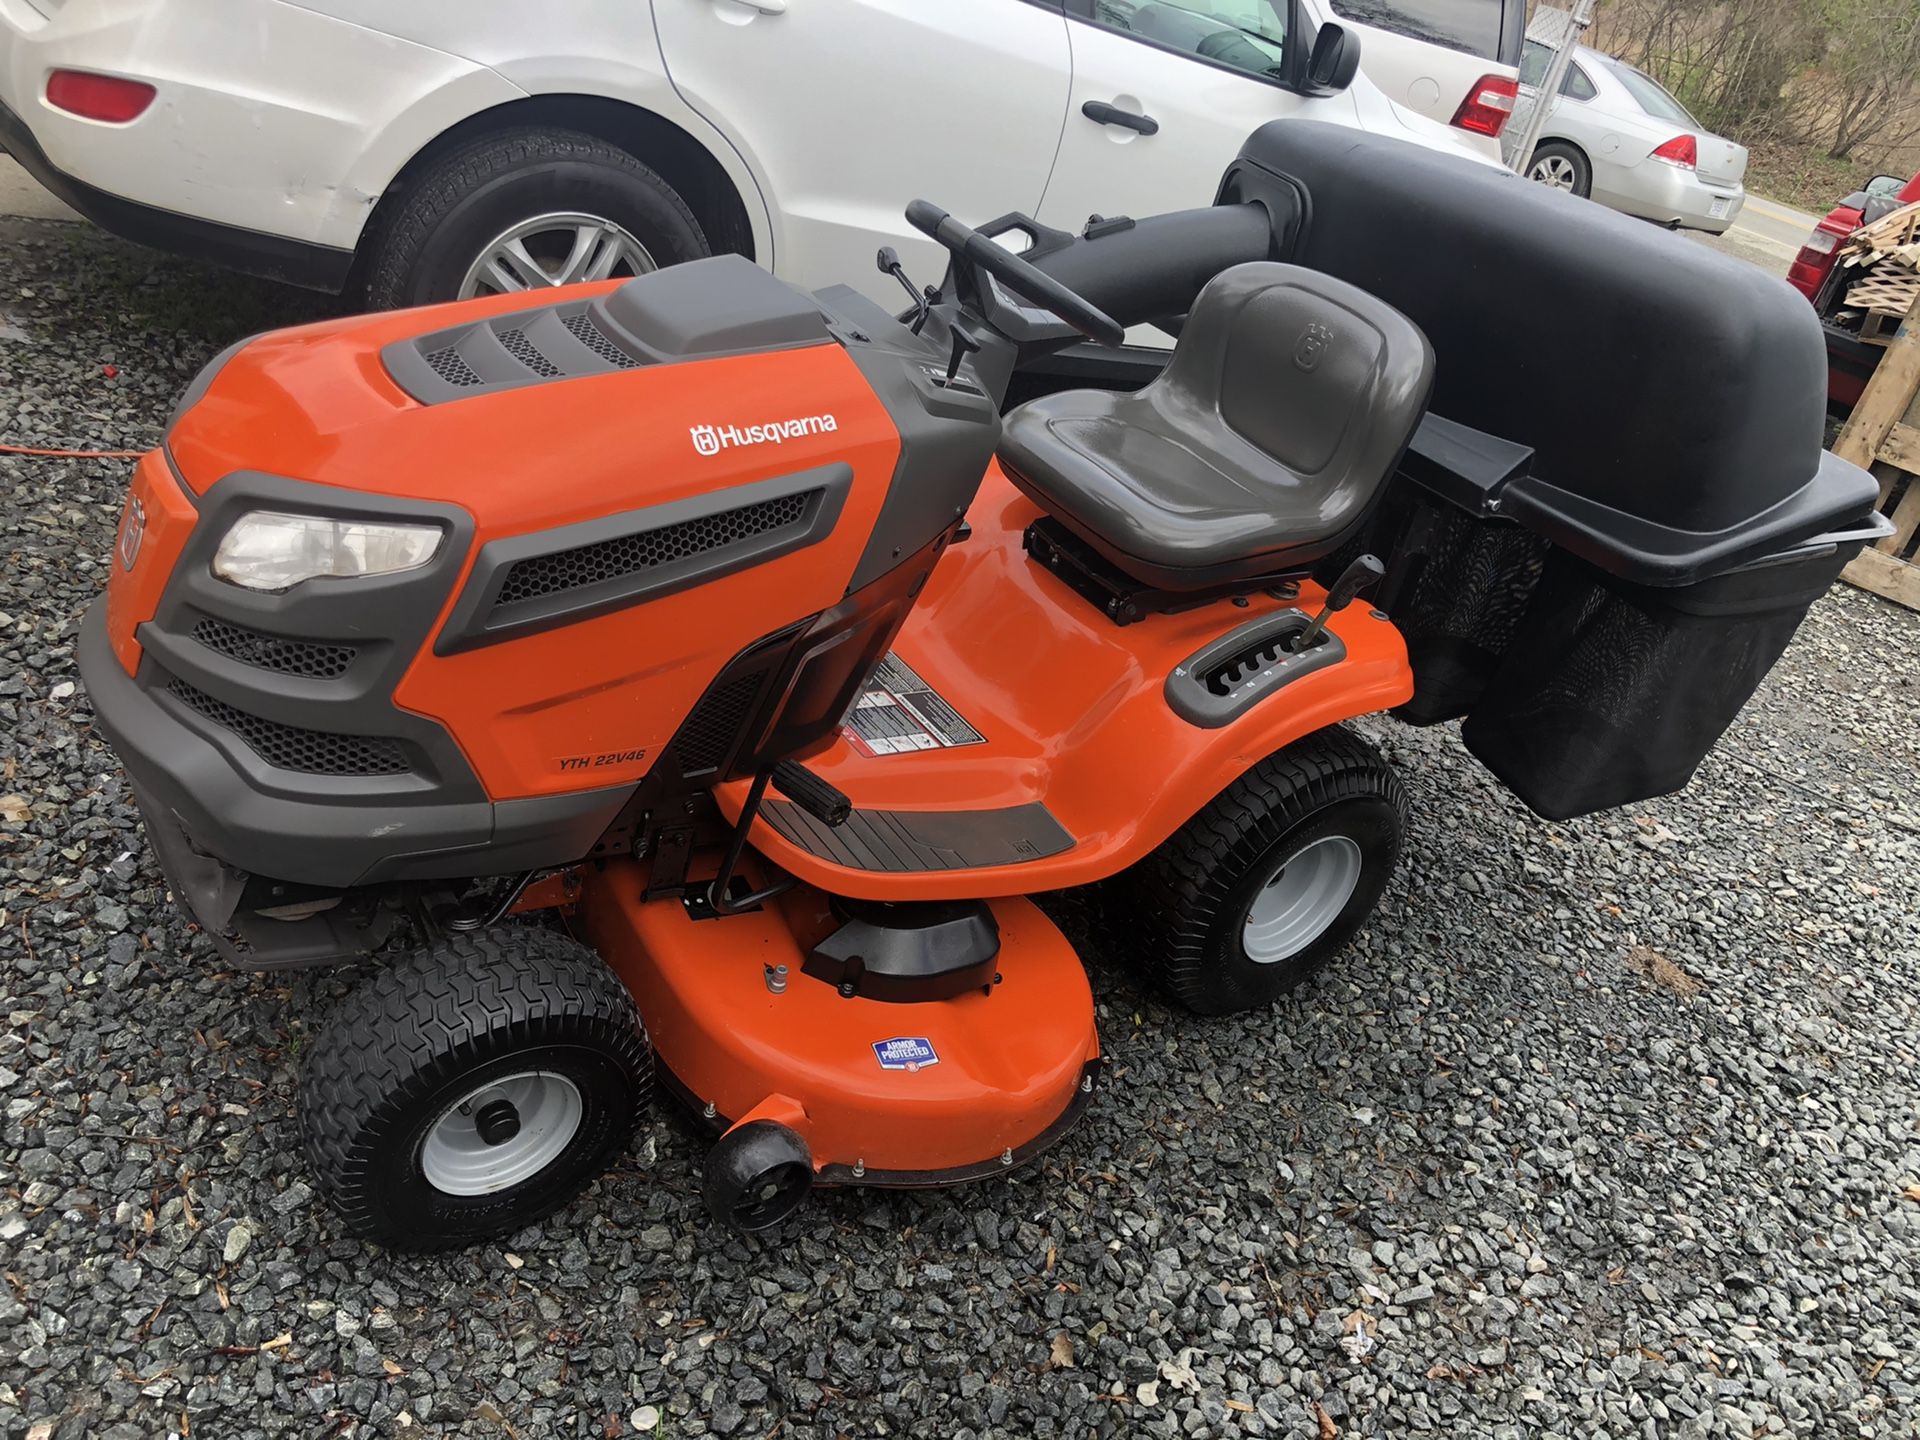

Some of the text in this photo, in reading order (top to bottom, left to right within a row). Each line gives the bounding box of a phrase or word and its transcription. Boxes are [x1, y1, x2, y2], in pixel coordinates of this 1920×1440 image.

[717, 413, 838, 448] Husqvarna
[560, 750, 646, 770] YTH 22V46
[881, 1047, 930, 1060] PROTECTED
[886, 1040, 917, 1051] ARMOR
